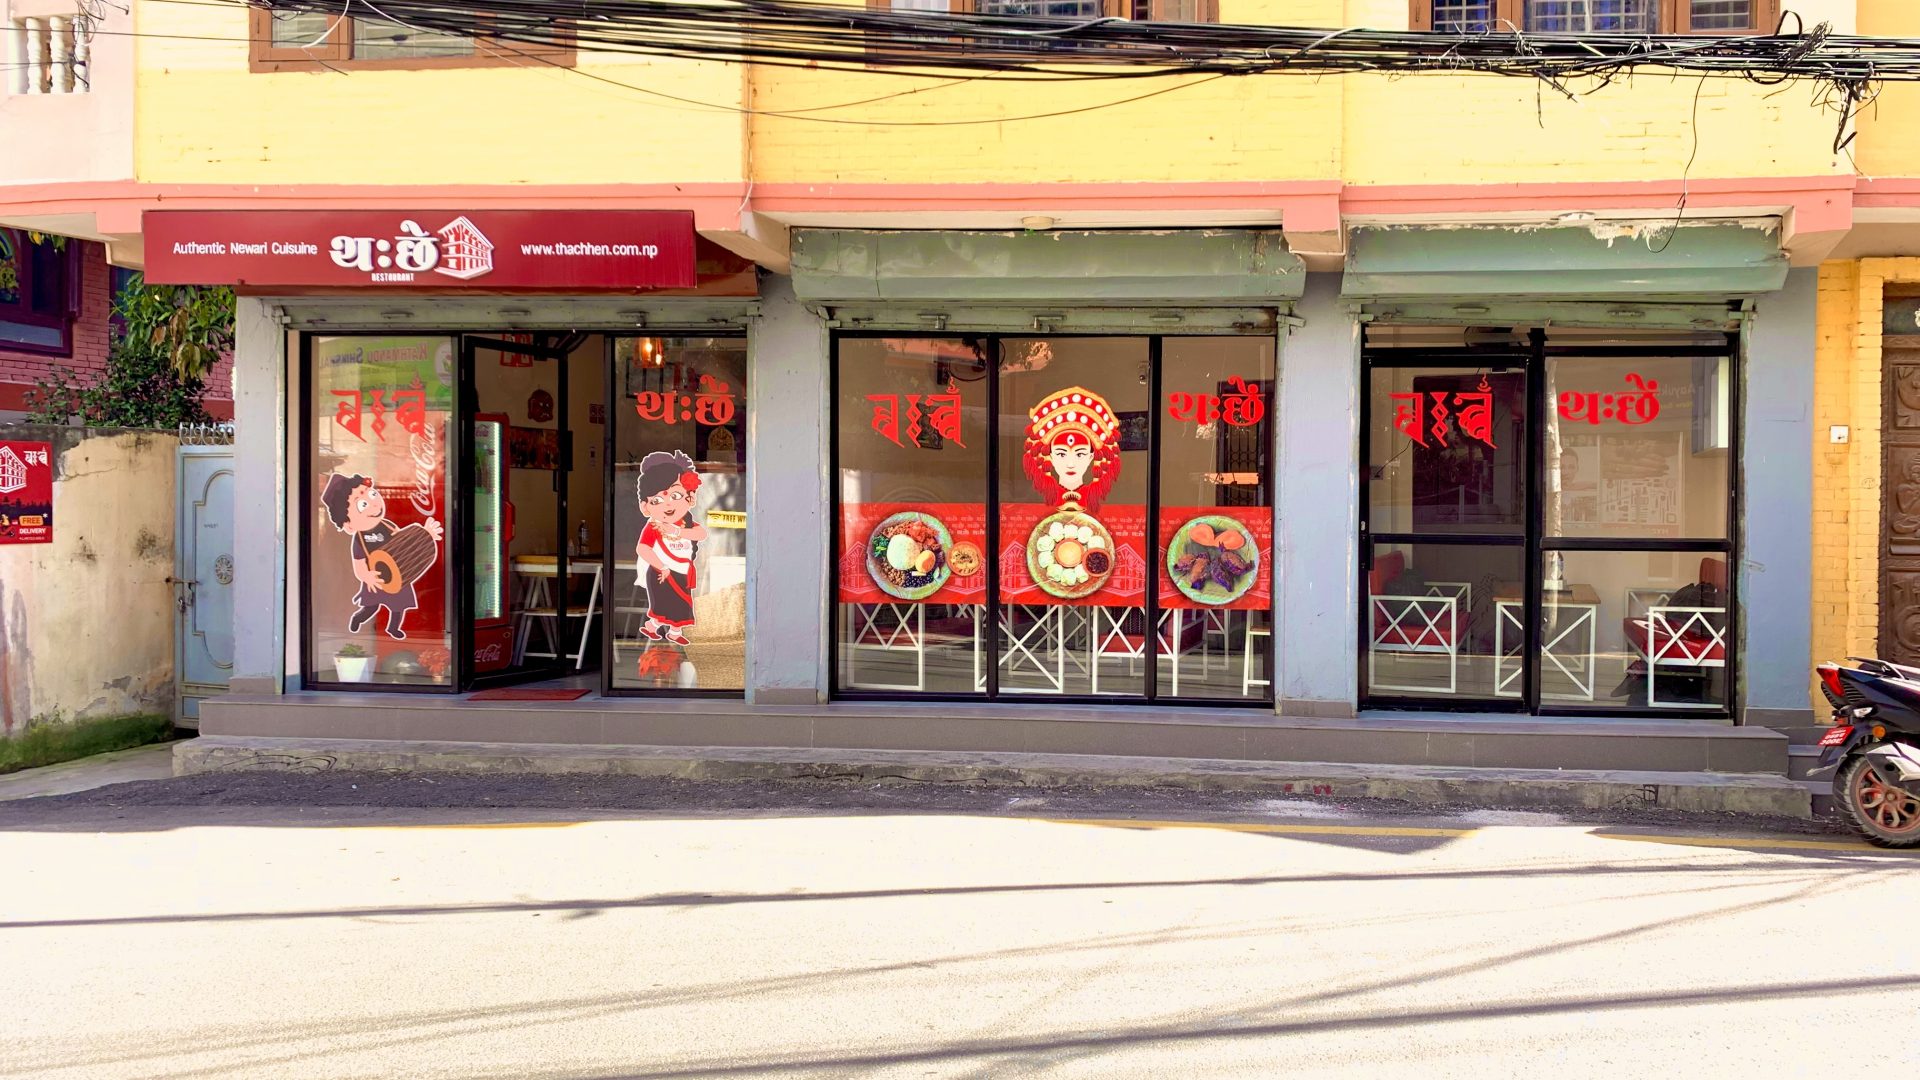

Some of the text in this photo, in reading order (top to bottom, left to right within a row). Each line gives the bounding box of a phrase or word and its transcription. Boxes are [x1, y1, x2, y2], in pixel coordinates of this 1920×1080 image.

[172, 241, 318, 255] Authentic Newari Cuisuine
[521, 241, 658, 258] www.thachhen.com.np
[22, 516, 41, 525] FREE
[723, 514, 736, 523] FREE
[19, 527, 46, 535] DELIVERY
